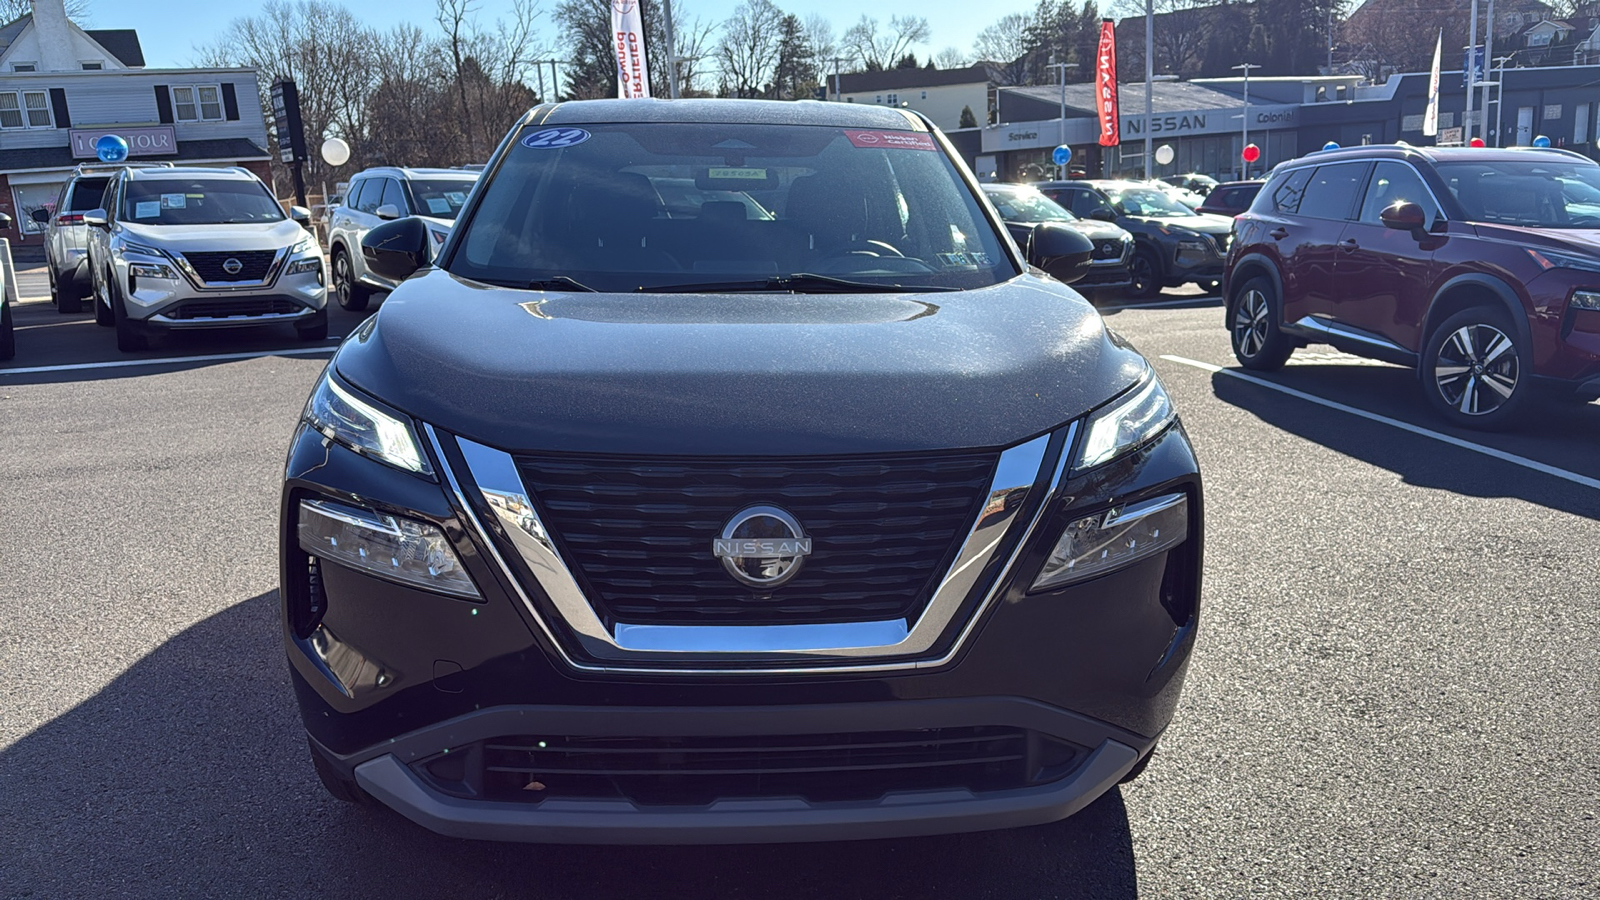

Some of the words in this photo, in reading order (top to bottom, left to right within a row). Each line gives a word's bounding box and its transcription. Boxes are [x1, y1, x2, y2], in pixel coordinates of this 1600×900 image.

[1126, 114, 1206, 135] NISSAN
[1257, 110, 1295, 124] Colonial
[88, 134, 169, 150] CTOUR
[529, 129, 582, 147] 22
[1008, 131, 1038, 141] Service
[717, 541, 809, 554] NISSAN
